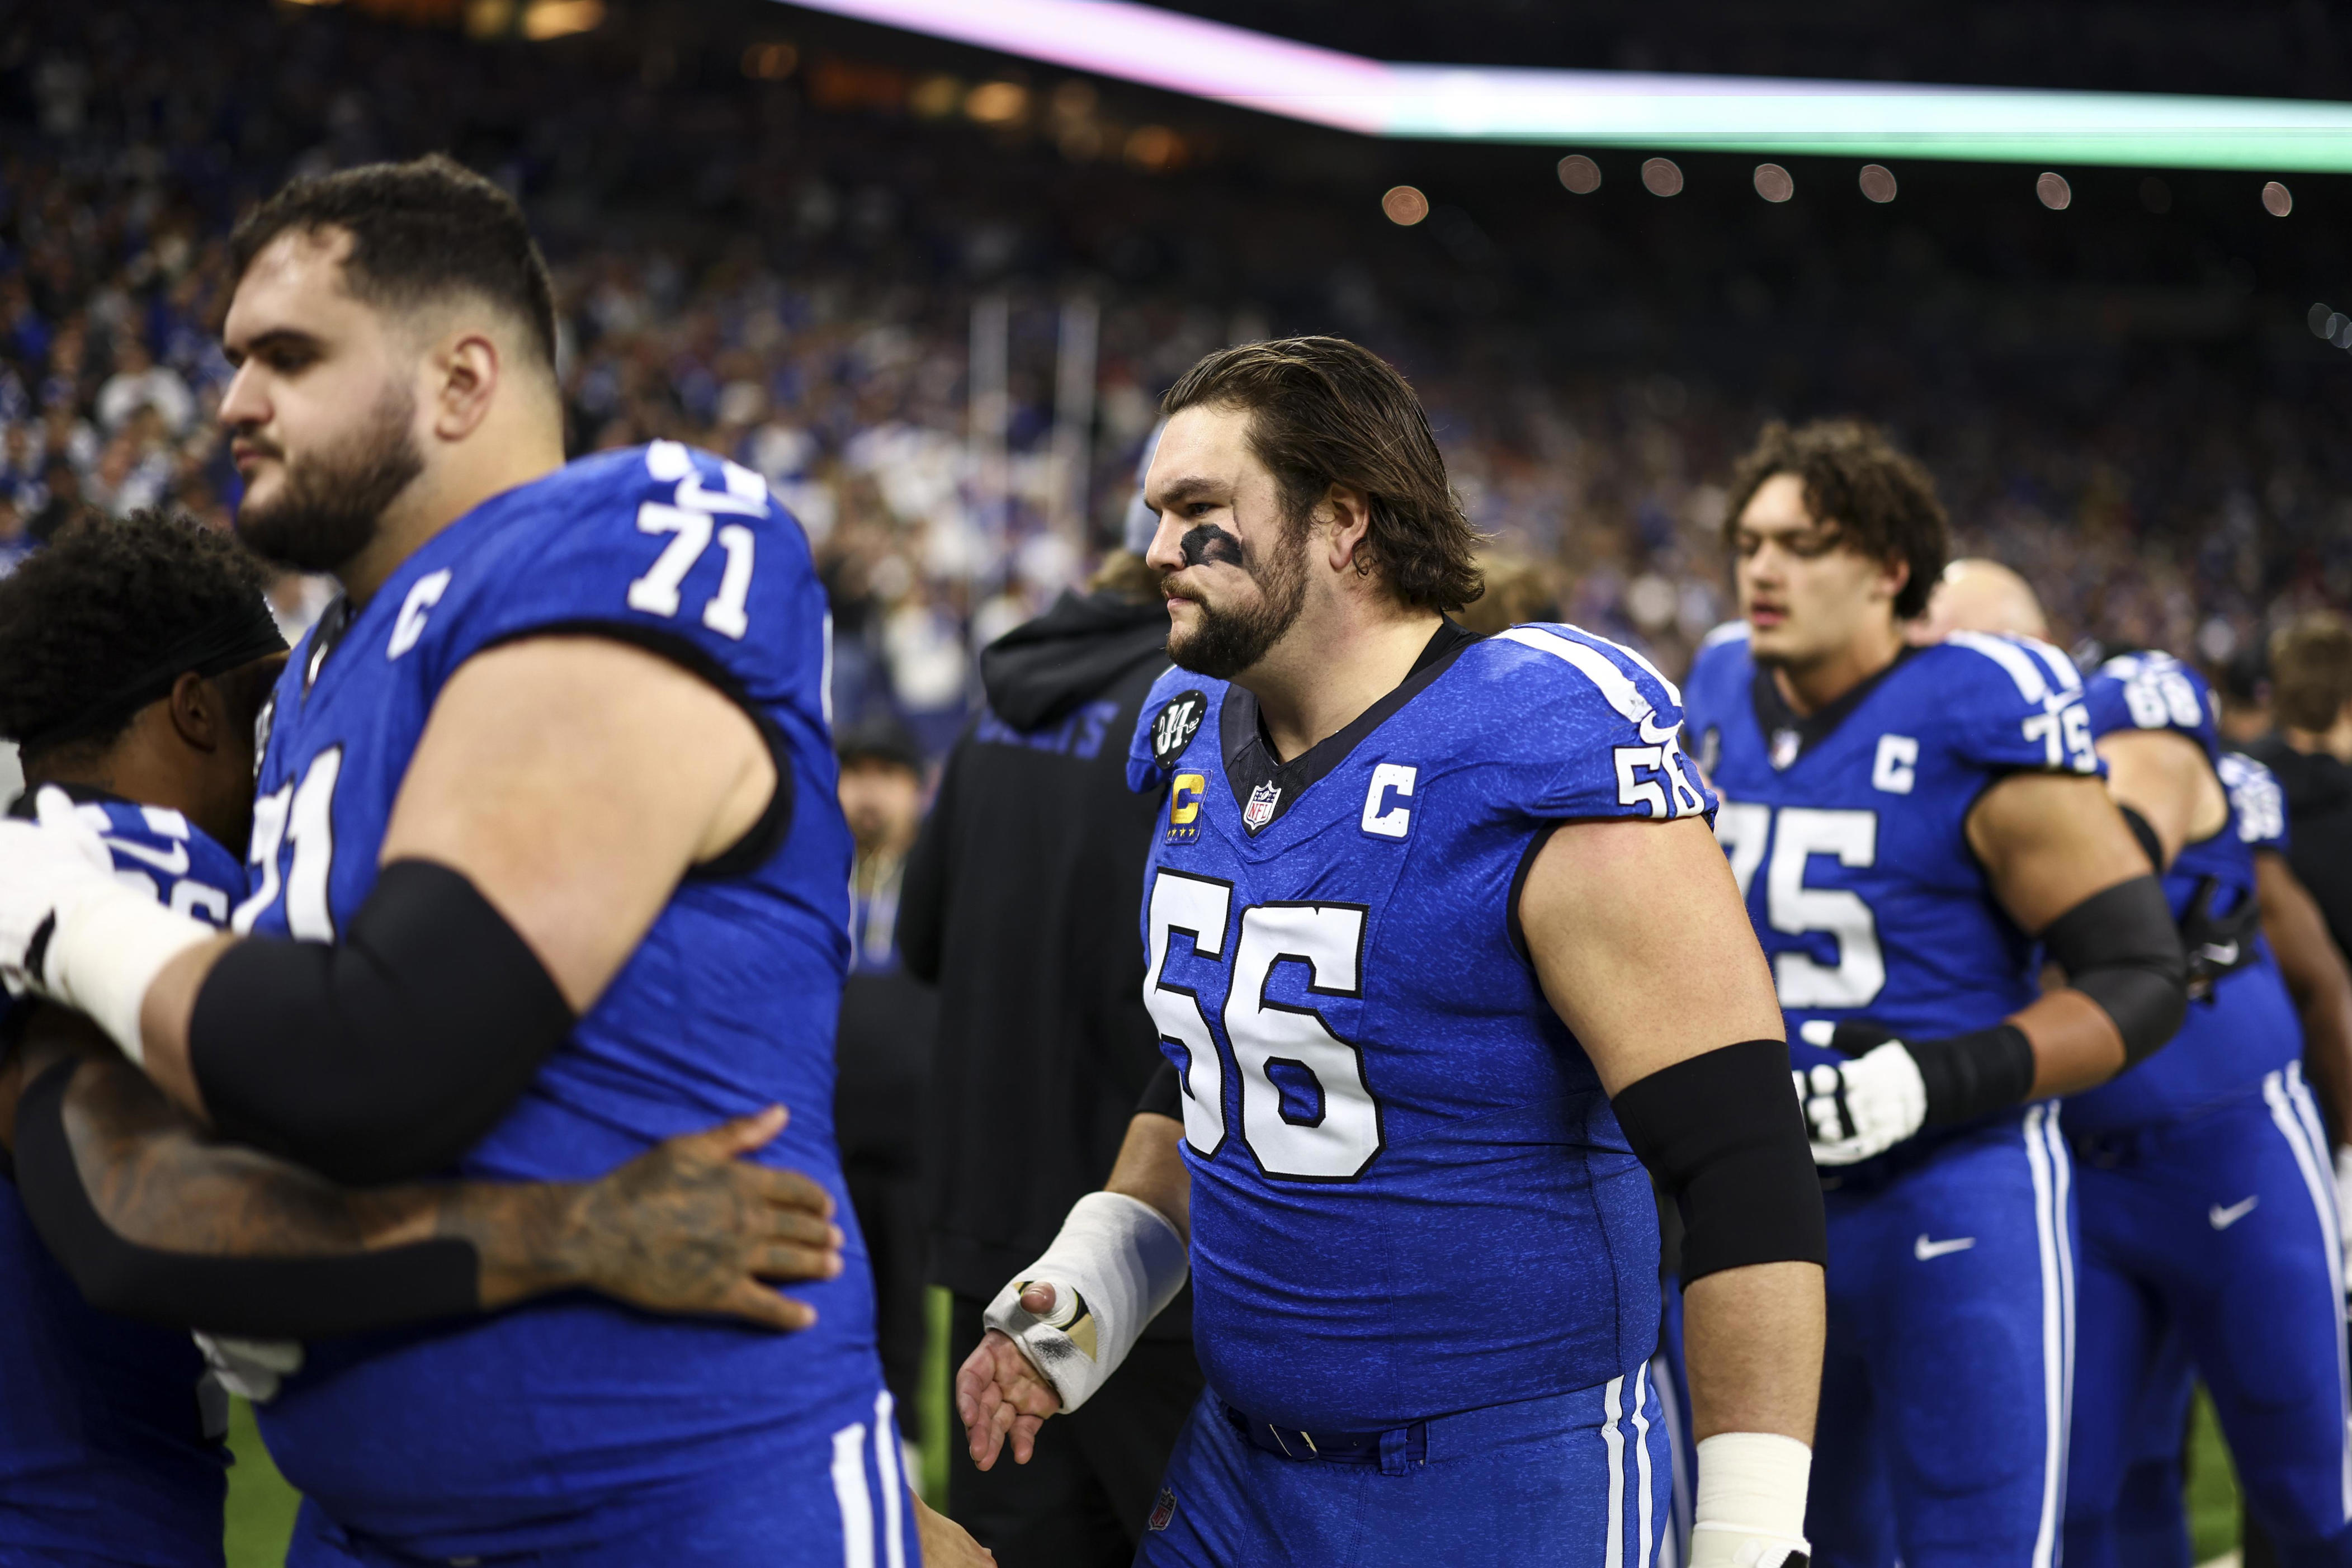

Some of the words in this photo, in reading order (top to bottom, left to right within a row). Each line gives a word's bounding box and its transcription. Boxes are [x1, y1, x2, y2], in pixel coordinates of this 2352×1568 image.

[628, 500, 755, 641] 71
[387, 567, 452, 661] C
[1613, 737, 1706, 818] 56
[1871, 732, 1919, 795] C
[2022, 703, 2098, 773] 75
[1171, 774, 1205, 824] C
[1248, 802, 1268, 821] NFL
[1362, 763, 1417, 838] C
[231, 744, 343, 946] 71
[1715, 801, 1886, 1009] 75
[1143, 866, 1387, 1183] 56
